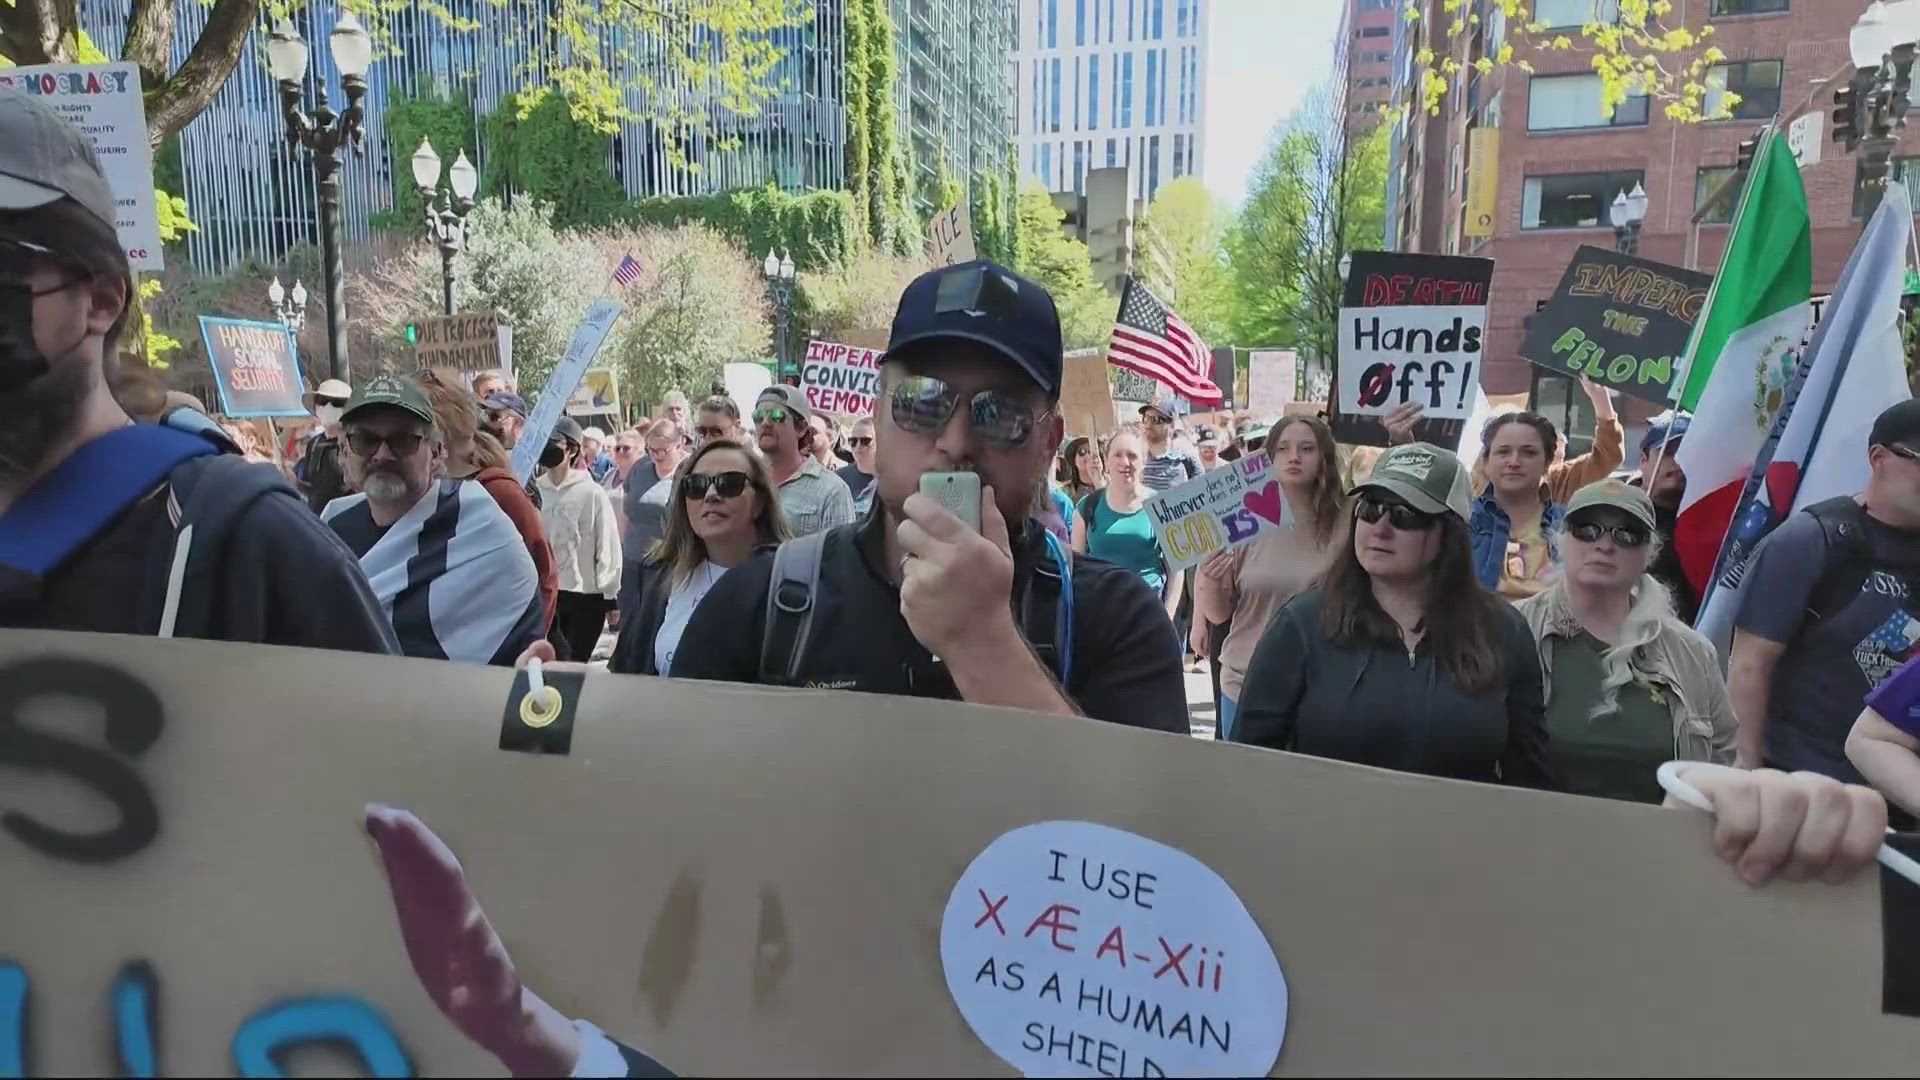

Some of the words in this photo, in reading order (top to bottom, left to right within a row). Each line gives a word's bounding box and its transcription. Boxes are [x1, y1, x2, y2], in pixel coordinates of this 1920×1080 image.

[0, 71, 128, 95] MOCRACY
[80, 125, 116, 133] QUALITY
[934, 207, 962, 254] ICE
[1568, 263, 1708, 327] IMPEAC
[416, 322, 440, 344] DUE
[442, 315, 498, 344] PROCESS
[1354, 317, 1482, 354] Hands
[1602, 309, 1649, 336] THE
[233, 347, 284, 371] SOCIAL
[805, 342, 883, 370] IMPEAC
[1551, 327, 1671, 384] FELON
[231, 368, 286, 391] SECURITY
[802, 364, 881, 395] CONVIC
[805, 387, 878, 417] REMOV
[1152, 492, 1206, 524] Whoever
[1241, 452, 1271, 475] LOVE
[1165, 510, 1222, 562] GOD
[1221, 508, 1259, 544] IS
[1047, 849, 1068, 883] I
[1081, 857, 1158, 909] USE
[974, 887, 1009, 937] X
[1024, 903, 1081, 953] Æ
[1096, 926, 1225, 993] A-Xii
[975, 956, 1025, 992] AS
[1038, 971, 1063, 1003] A
[1077, 978, 1231, 1053] HUMAN
